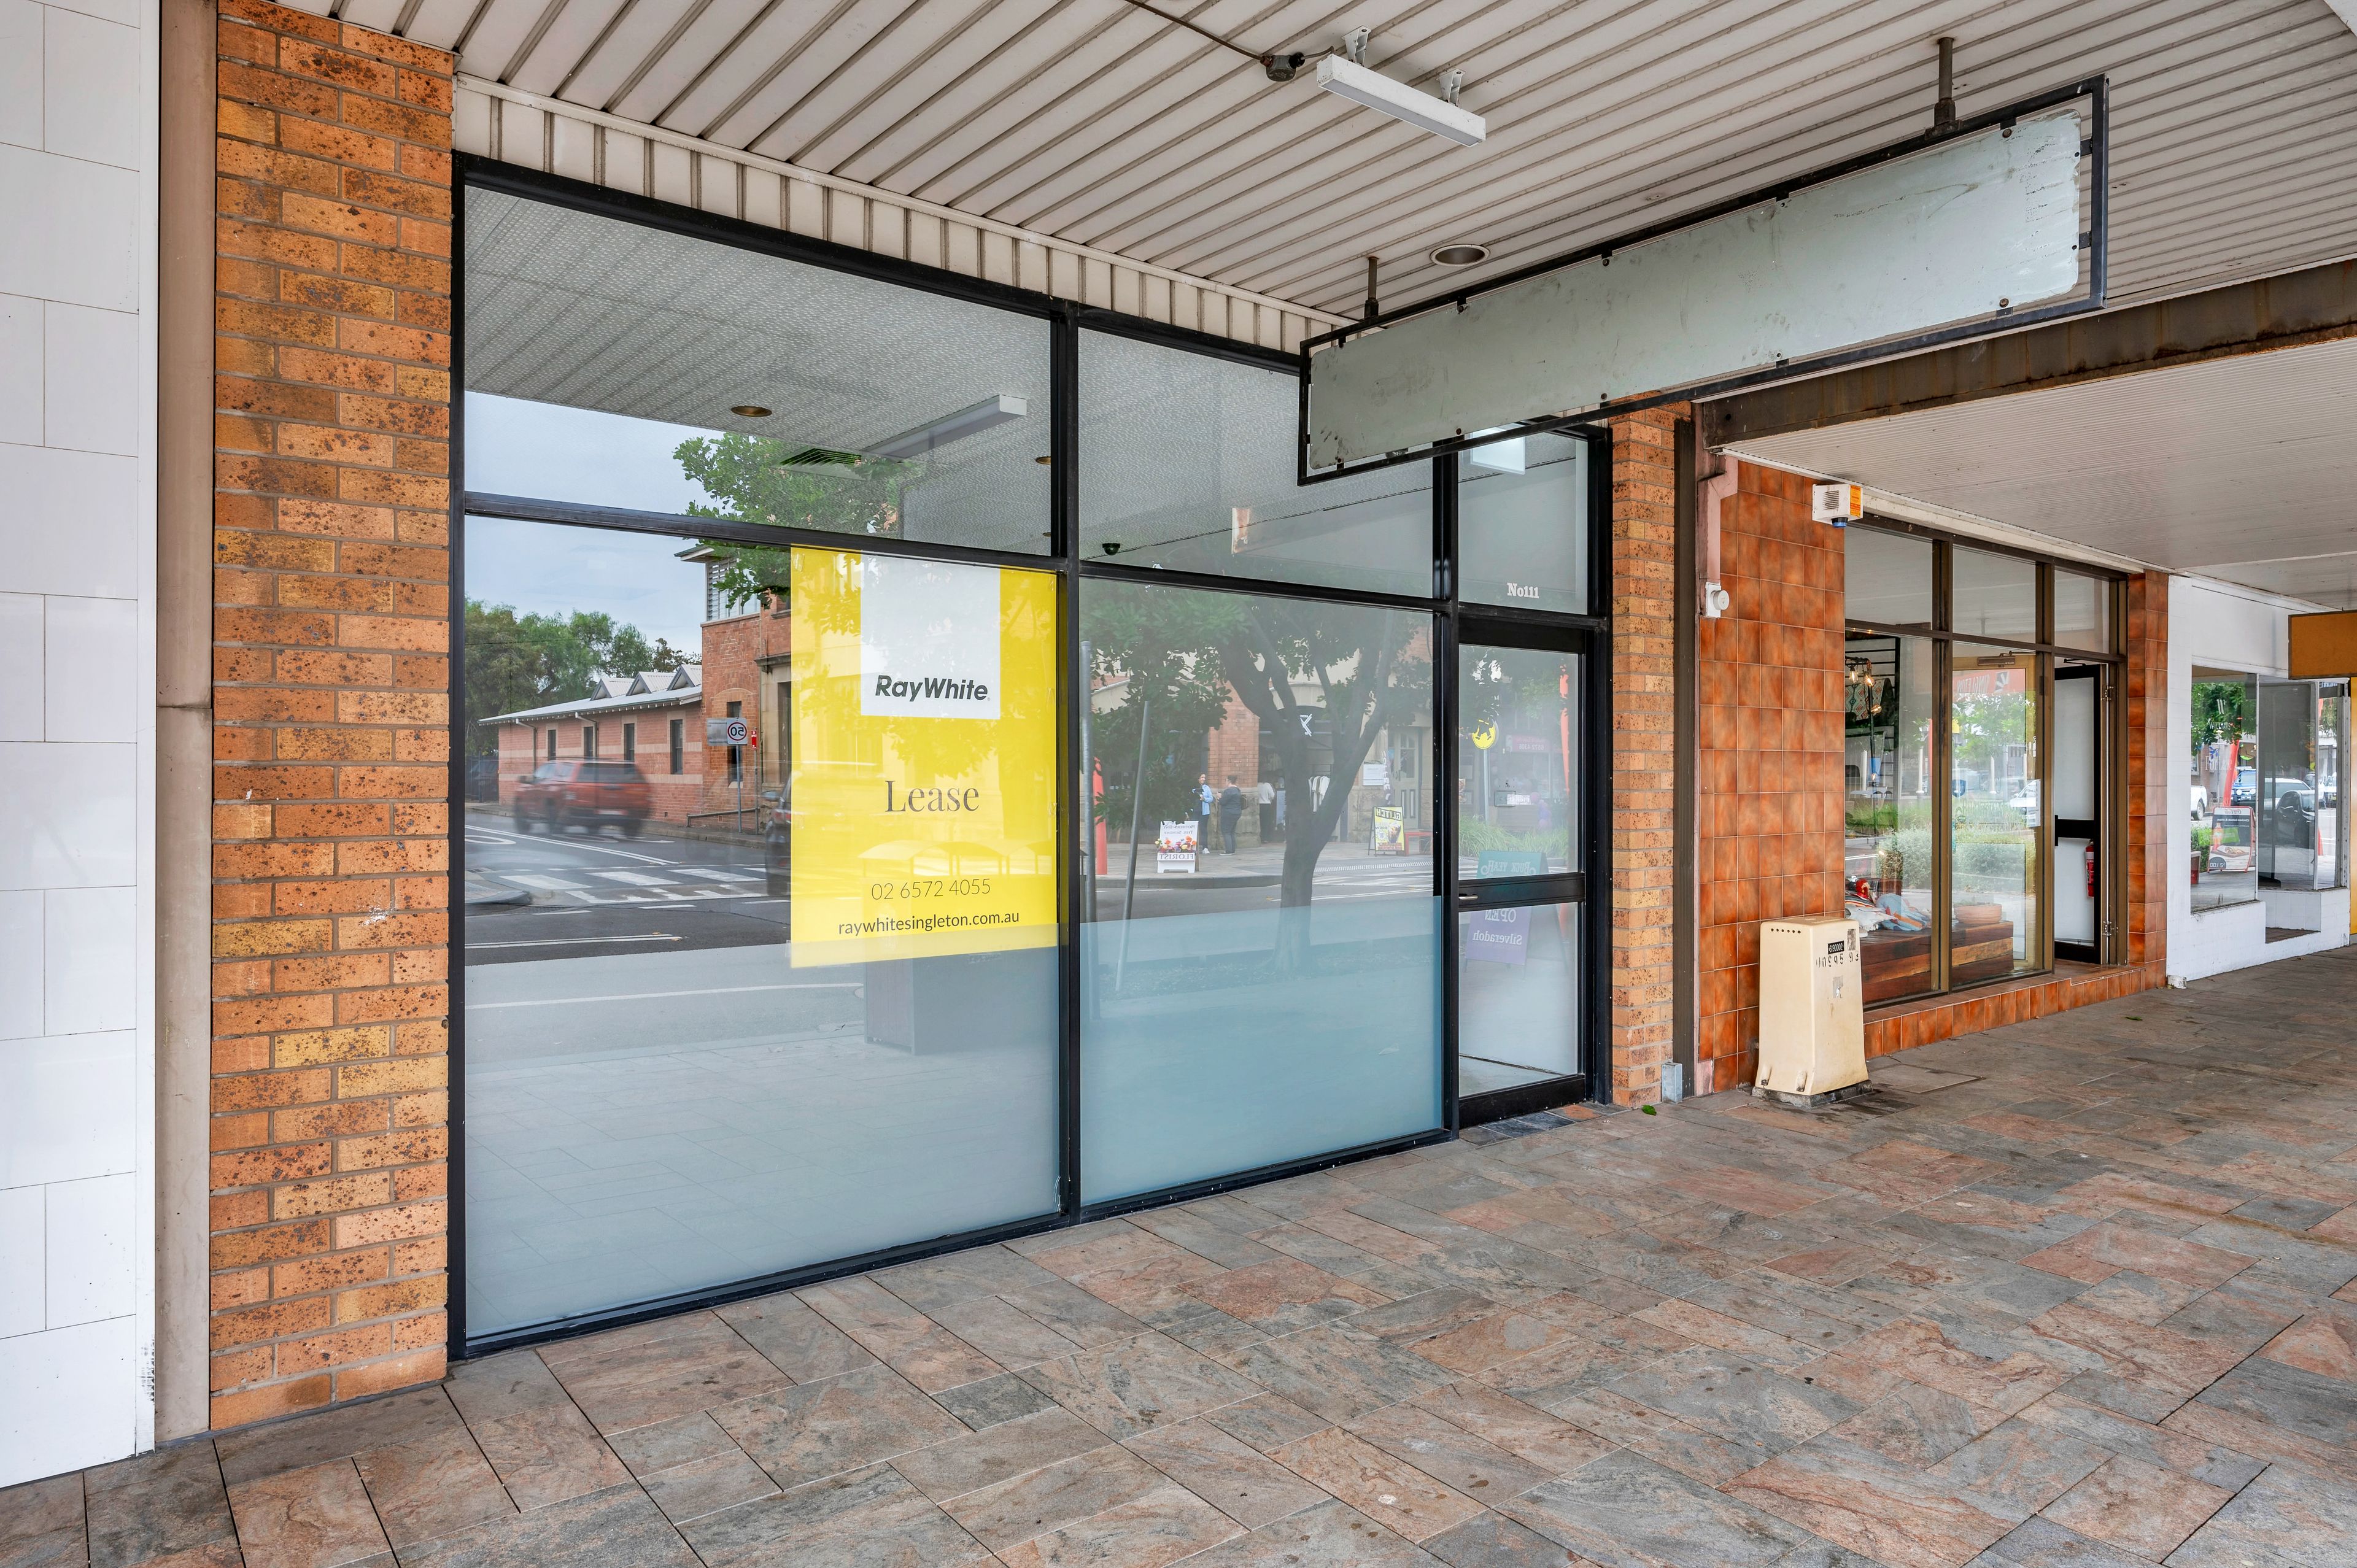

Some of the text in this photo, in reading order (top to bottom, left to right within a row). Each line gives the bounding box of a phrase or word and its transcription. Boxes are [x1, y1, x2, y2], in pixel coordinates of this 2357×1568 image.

[875, 674, 988, 702] RayWhite
[884, 780, 980, 813] Lease
[871, 878, 991, 900] 02 6572 4055
[838, 912, 1020, 937] raywhitesingleton.com.au
